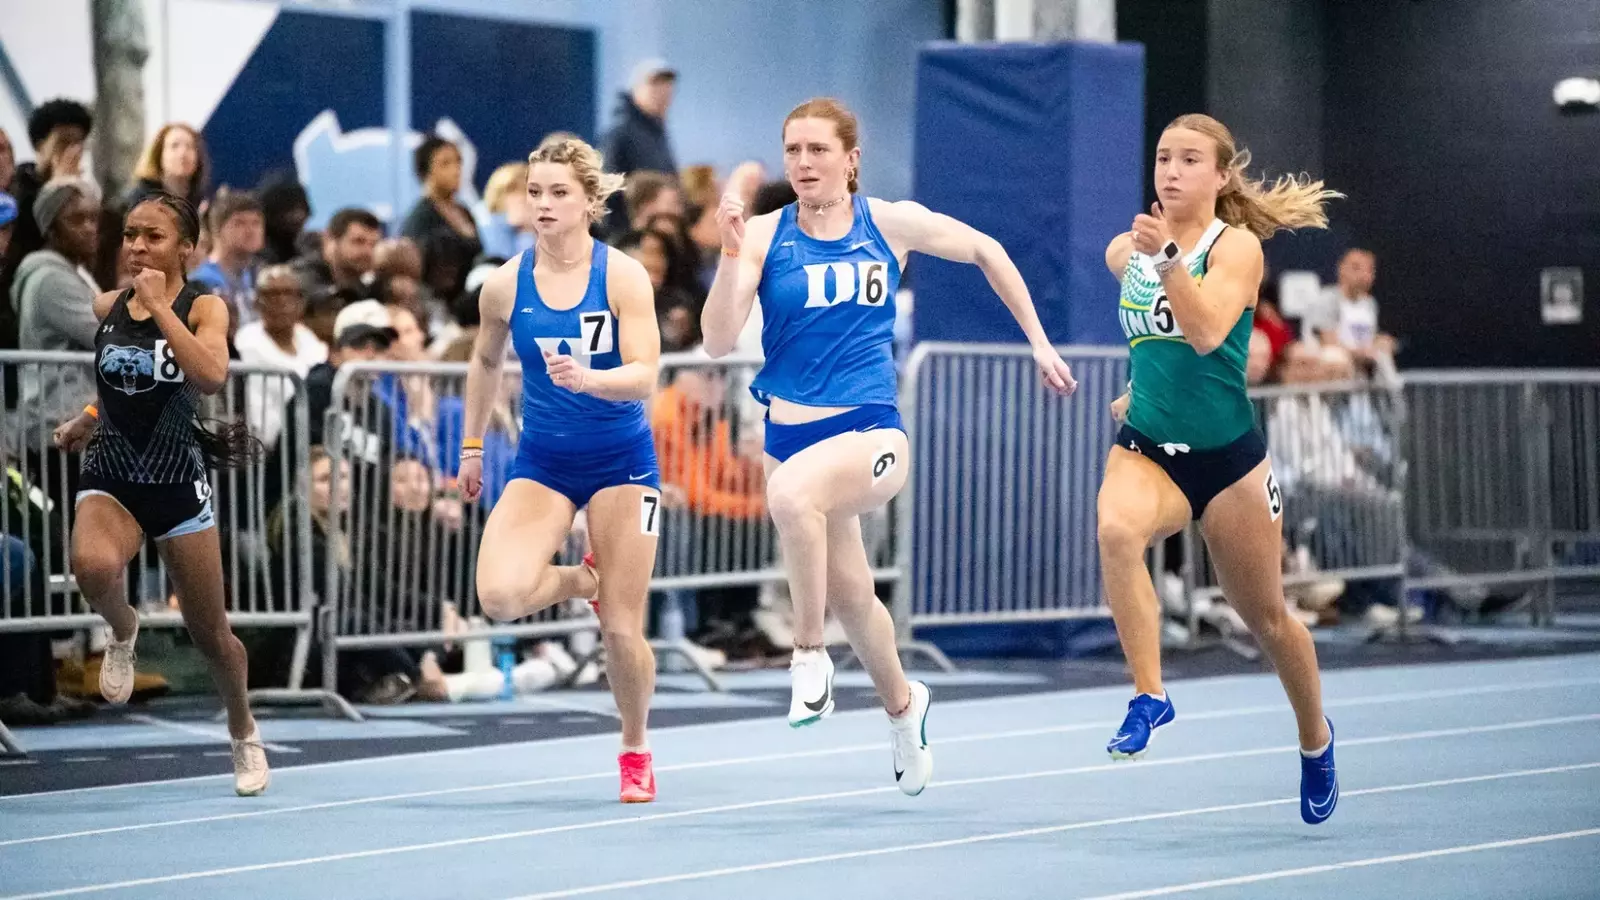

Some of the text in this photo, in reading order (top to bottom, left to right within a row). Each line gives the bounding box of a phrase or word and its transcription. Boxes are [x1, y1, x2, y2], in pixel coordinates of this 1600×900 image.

[866, 264, 883, 304] 6
[583, 315, 605, 351] 7
[1154, 295, 1174, 334] 5
[161, 343, 180, 380] 8
[873, 452, 896, 478] 6
[1266, 473, 1281, 514] 5
[644, 496, 658, 532] 7
